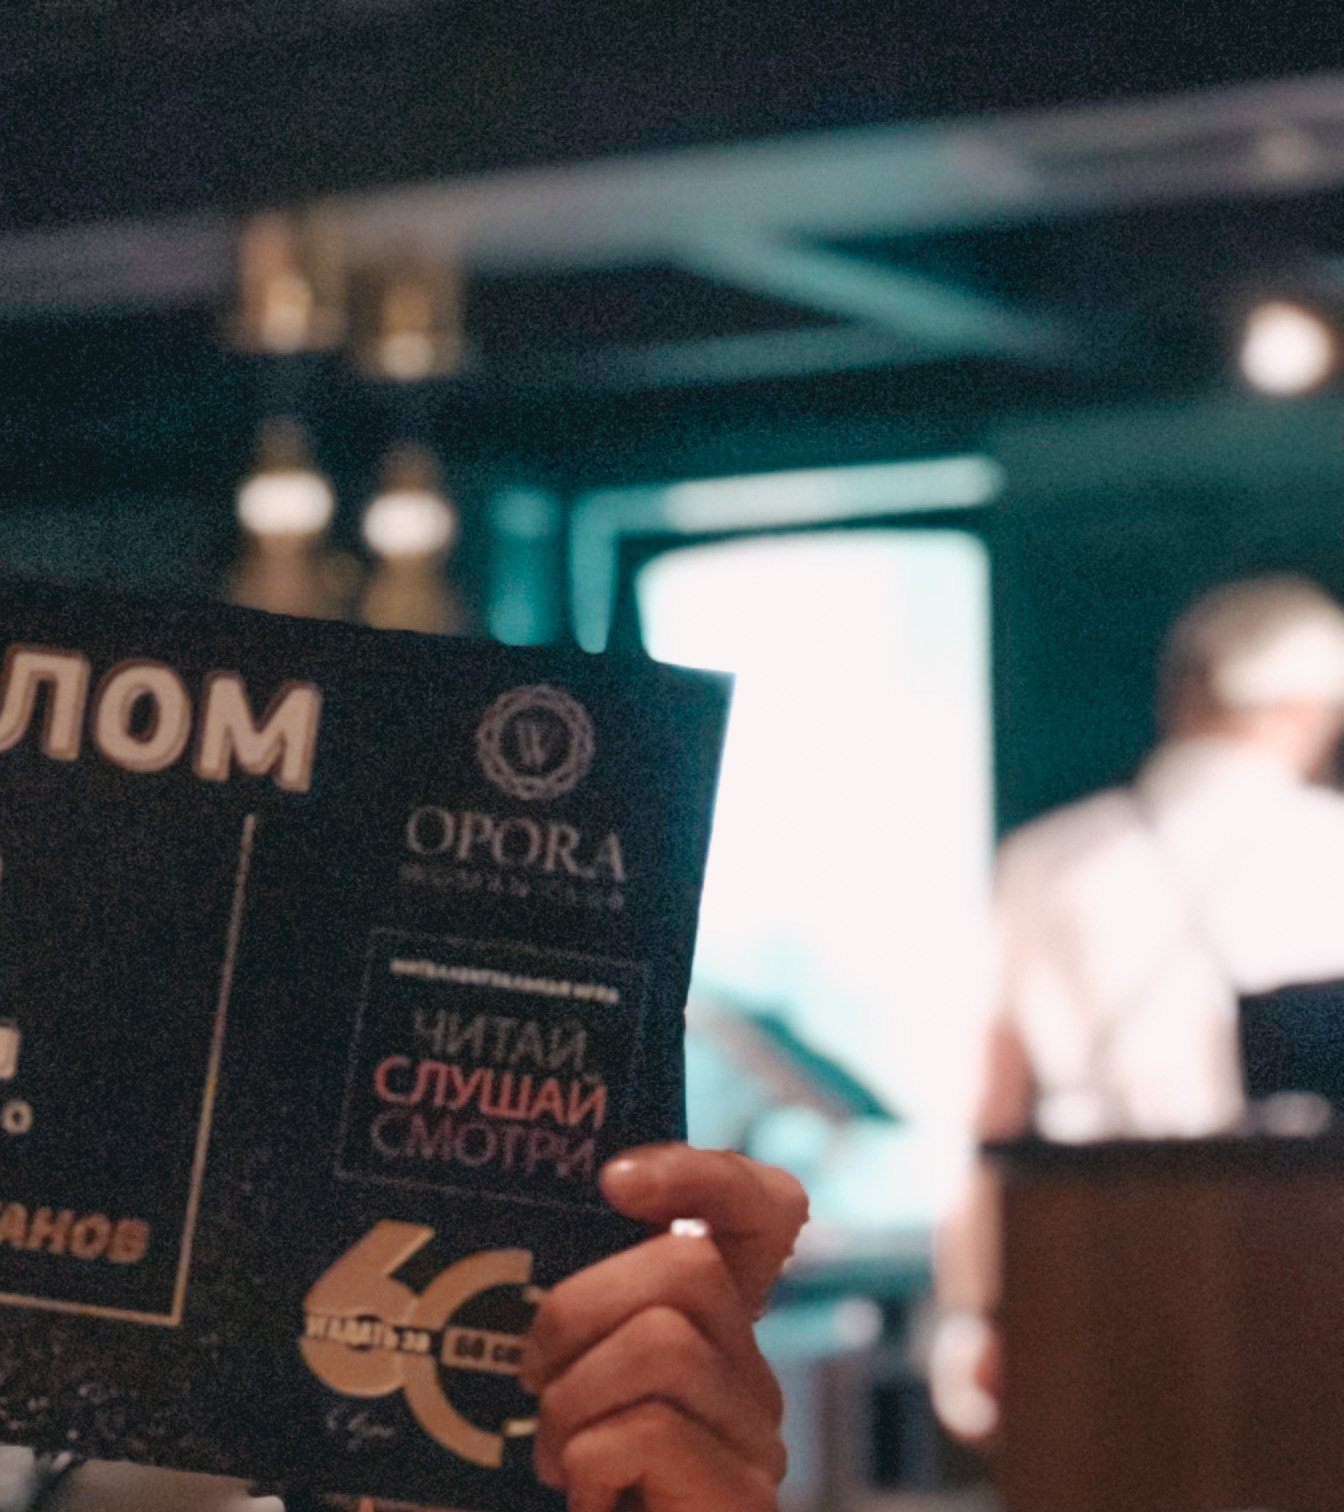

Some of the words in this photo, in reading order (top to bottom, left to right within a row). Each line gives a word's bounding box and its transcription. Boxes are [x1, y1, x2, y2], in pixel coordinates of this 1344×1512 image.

[406, 805, 626, 882] OPORA
[415, 1008, 588, 1071] ЧИТАЙ
[372, 1053, 609, 1130] СЛУШАЙ
[370, 1110, 596, 1178] СМОТРИ
